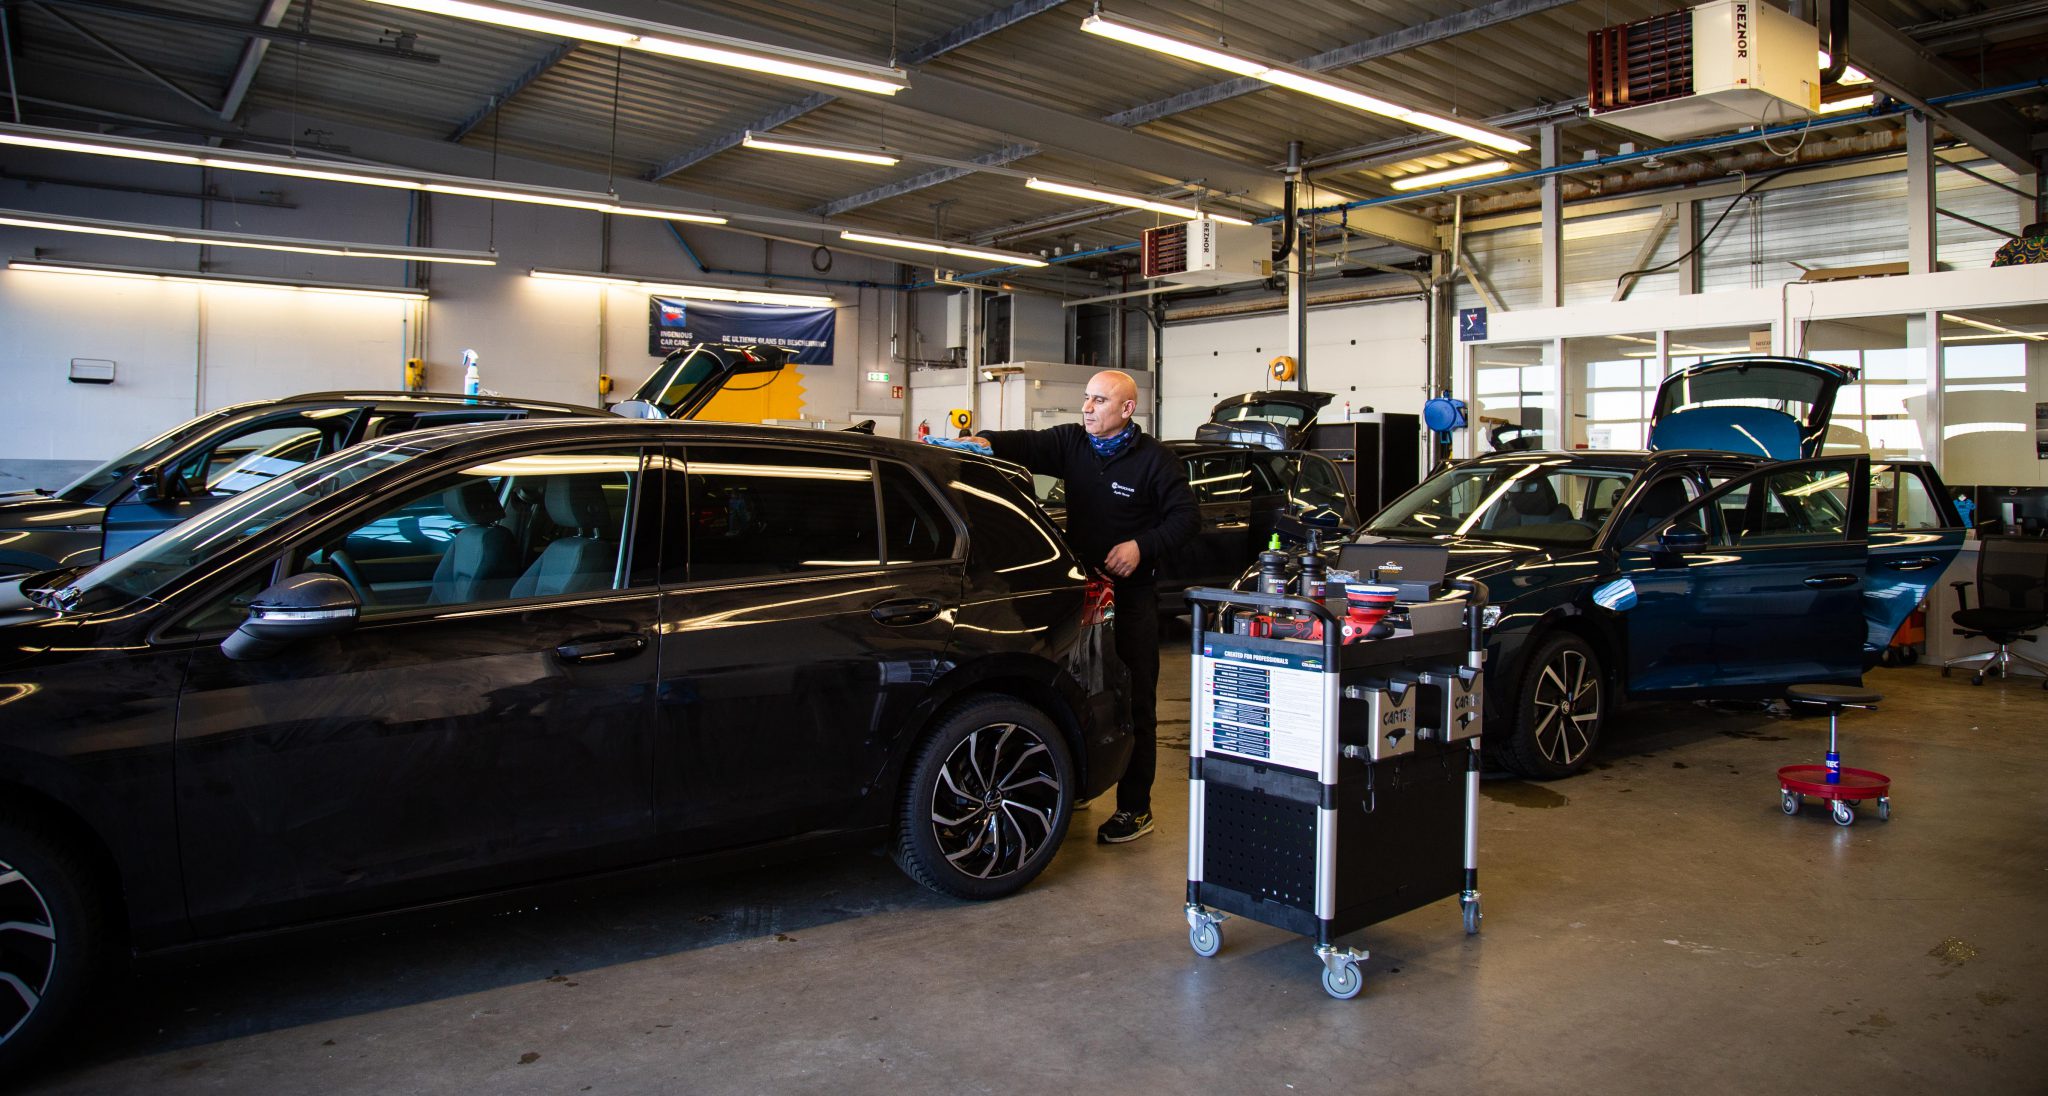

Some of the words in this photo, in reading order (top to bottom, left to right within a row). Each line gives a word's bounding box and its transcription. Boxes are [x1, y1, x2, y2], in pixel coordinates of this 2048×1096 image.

[1736, 4, 1747, 58] REZNOR
[660, 331, 693, 339] INGENIOUS
[722, 335, 730, 343] DE
[731, 335, 757, 344] ULTIEME
[758, 337, 777, 345] GLANS
[778, 338, 786, 346] EN
[673, 339, 690, 347] CARE
[1224, 650, 1244, 659] CREATED
[1253, 654, 1288, 665] PROFESSIONALS
